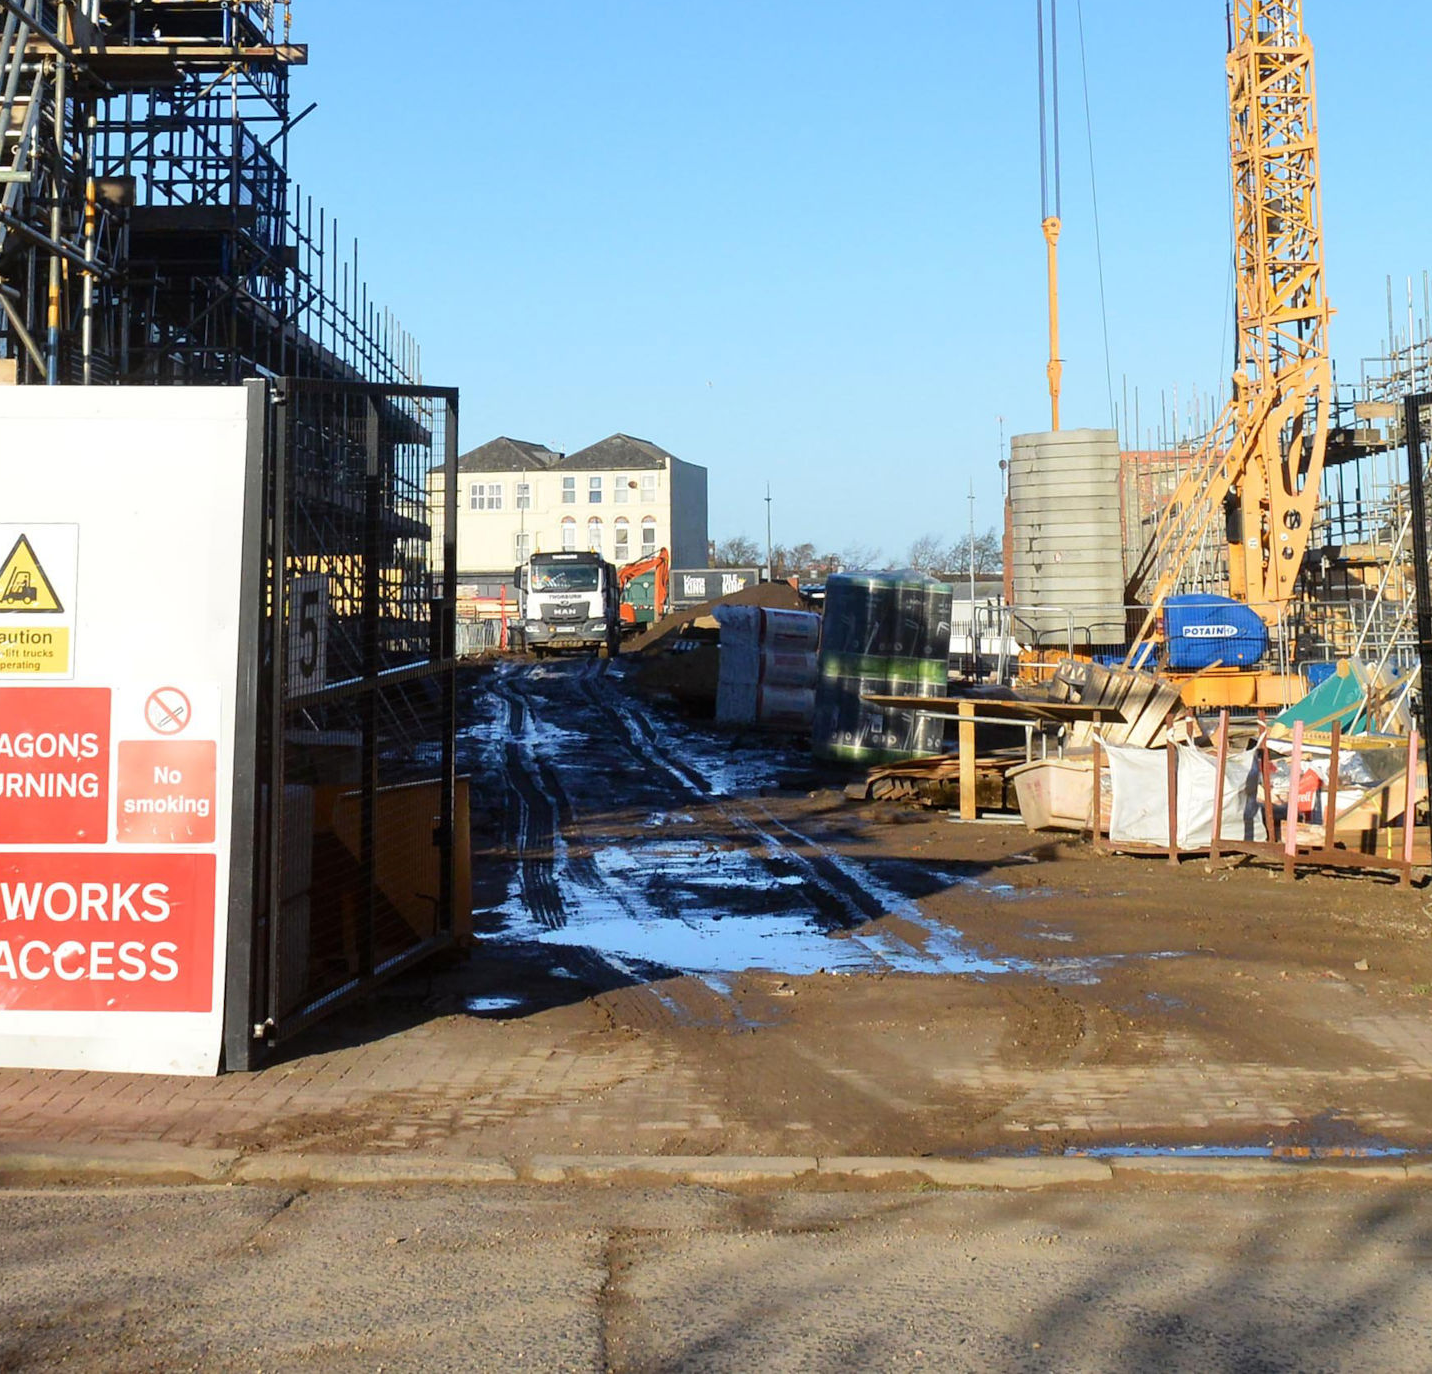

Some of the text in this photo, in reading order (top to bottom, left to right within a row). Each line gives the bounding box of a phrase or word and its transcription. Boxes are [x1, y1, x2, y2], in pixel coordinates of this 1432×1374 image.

[299, 590, 319, 678] 5
[23, 649, 54, 658] trucks
[153, 766, 182, 786] No
[123, 793, 210, 818] smoking
[0, 881, 171, 922] WORKS
